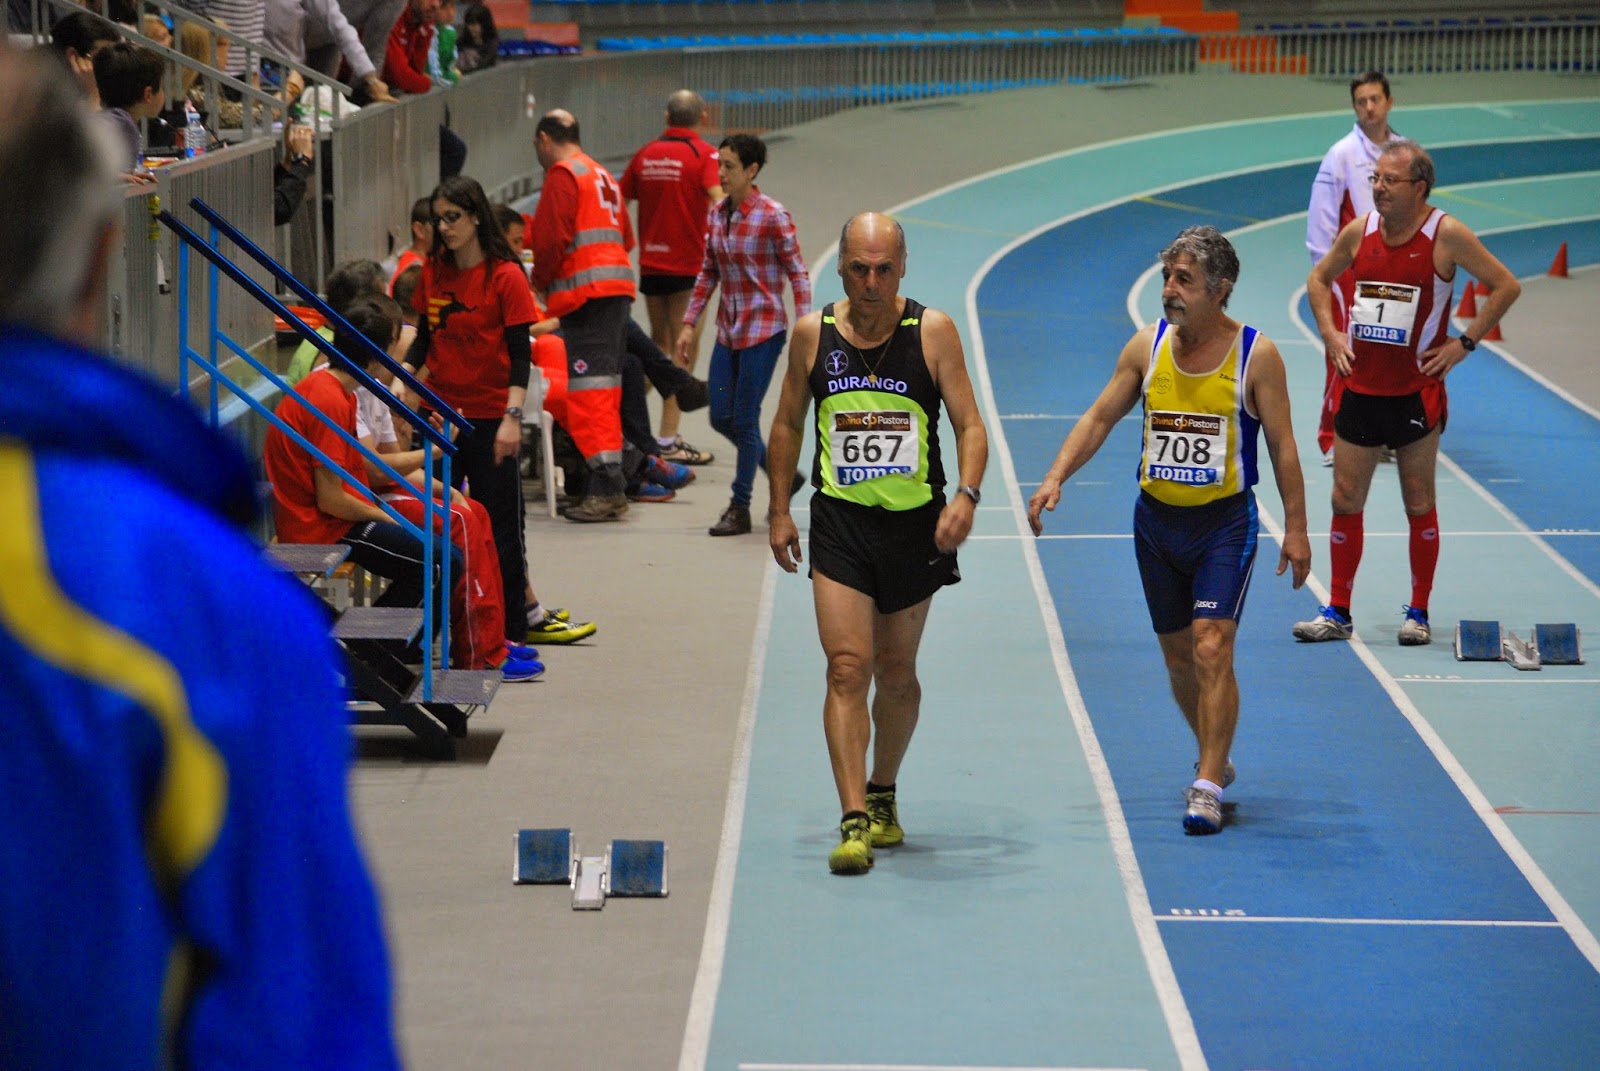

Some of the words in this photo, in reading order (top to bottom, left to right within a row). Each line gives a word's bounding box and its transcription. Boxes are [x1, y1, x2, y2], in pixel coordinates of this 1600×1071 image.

[1376, 302, 1385, 323] 1
[828, 376, 908, 393] DURANGO
[878, 416, 910, 425] Pastora
[1188, 419, 1219, 429] Pastora
[842, 435, 903, 463] 667
[1155, 435, 1211, 465] 708
